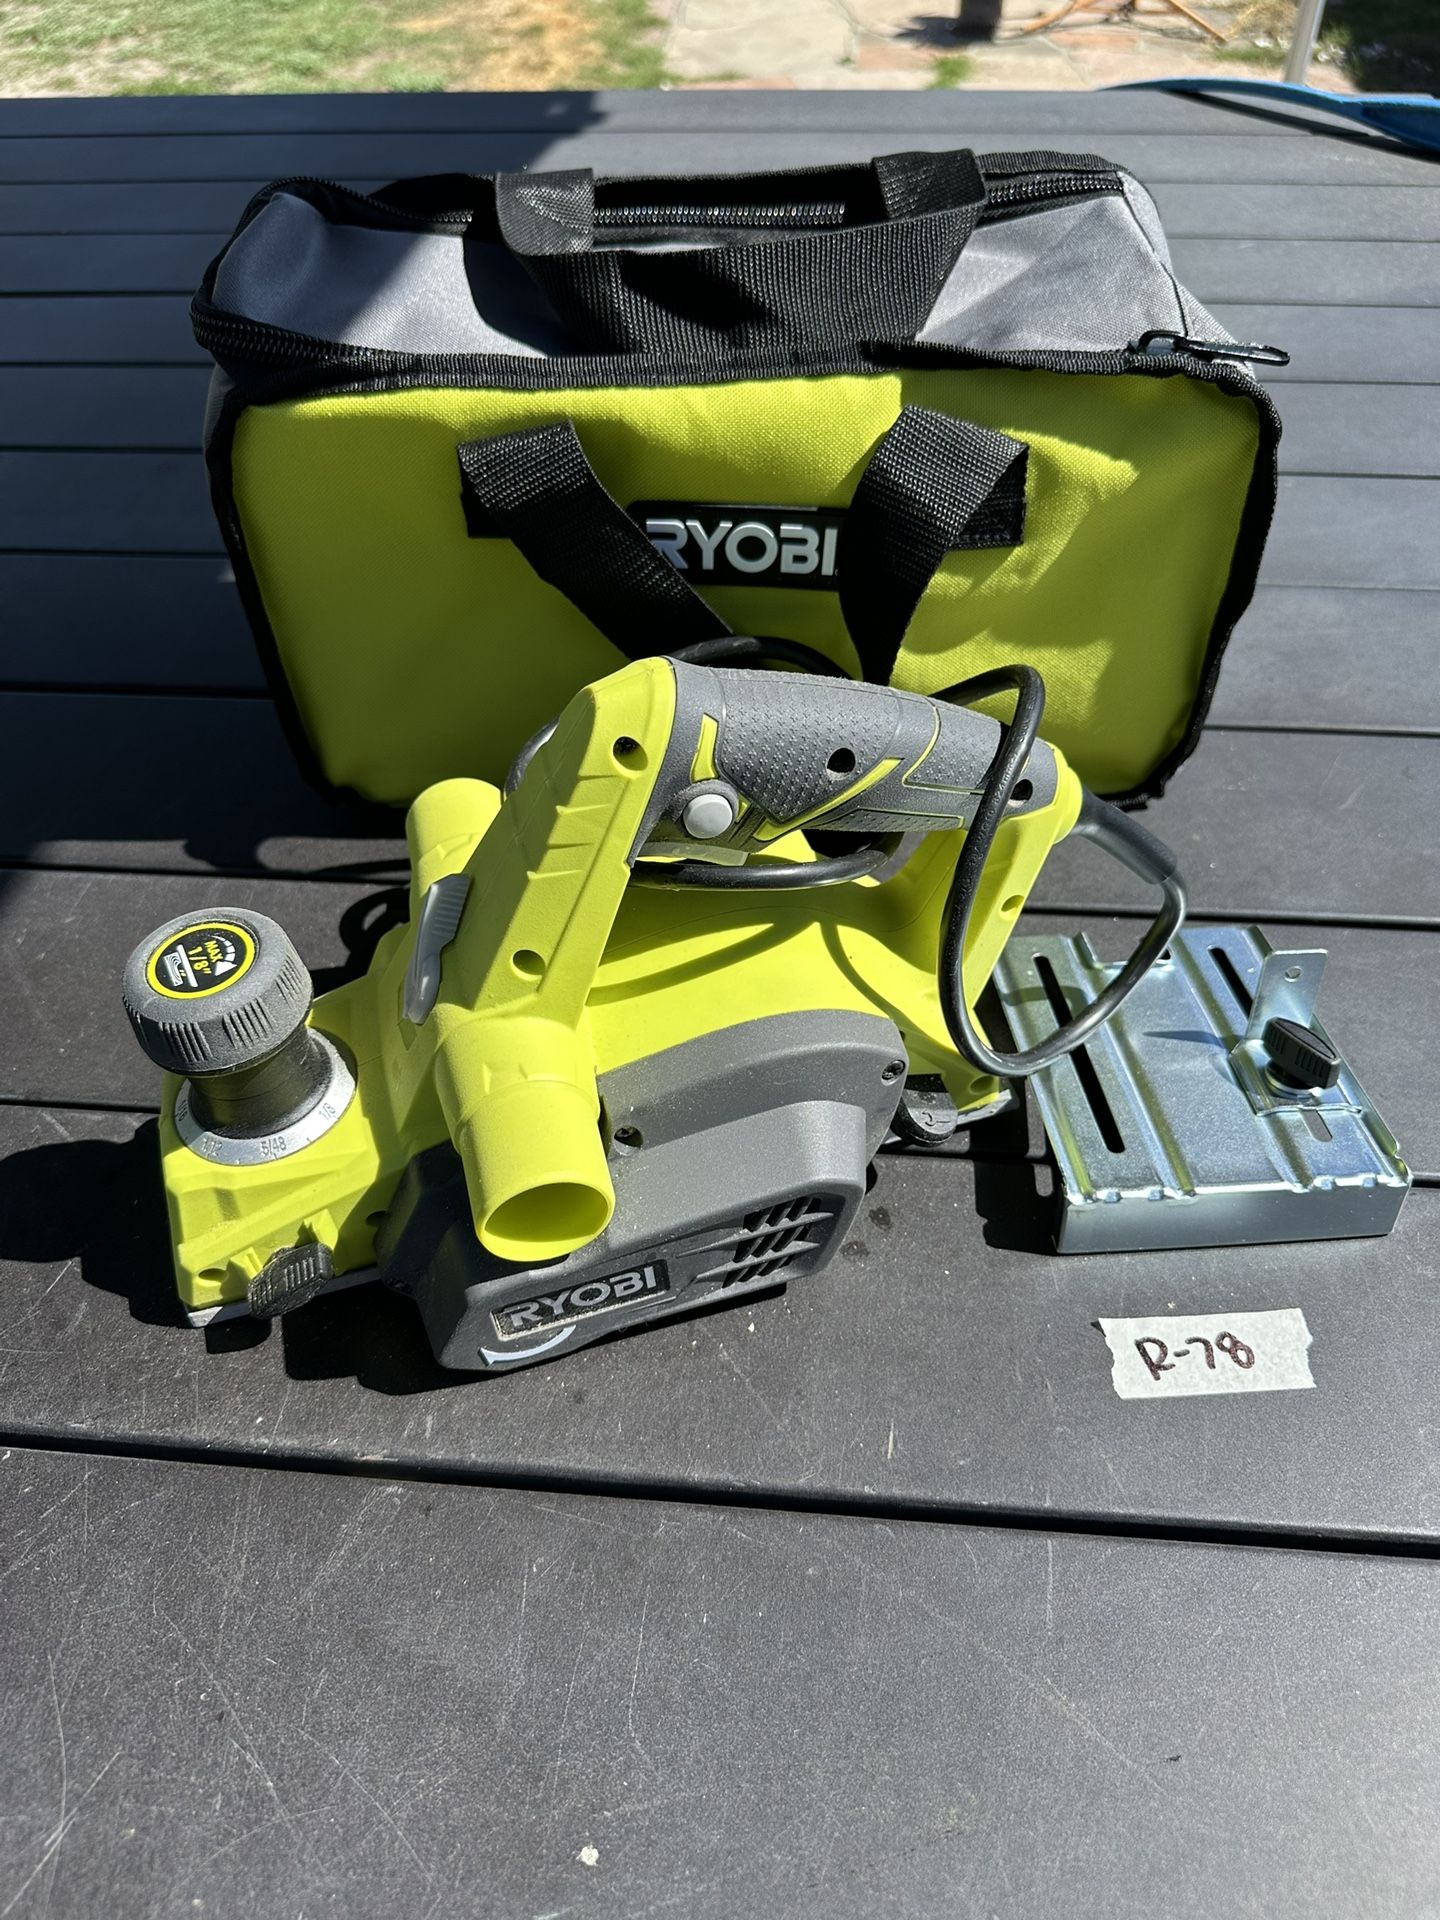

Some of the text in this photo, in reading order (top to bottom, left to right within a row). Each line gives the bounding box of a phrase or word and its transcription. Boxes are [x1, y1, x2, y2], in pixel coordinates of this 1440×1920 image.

[645, 518, 837, 576] RYOBI
[204, 940, 223, 962] MAX
[504, 1266, 657, 1327] RYOBI
[1134, 1331, 1256, 1381] R-78
